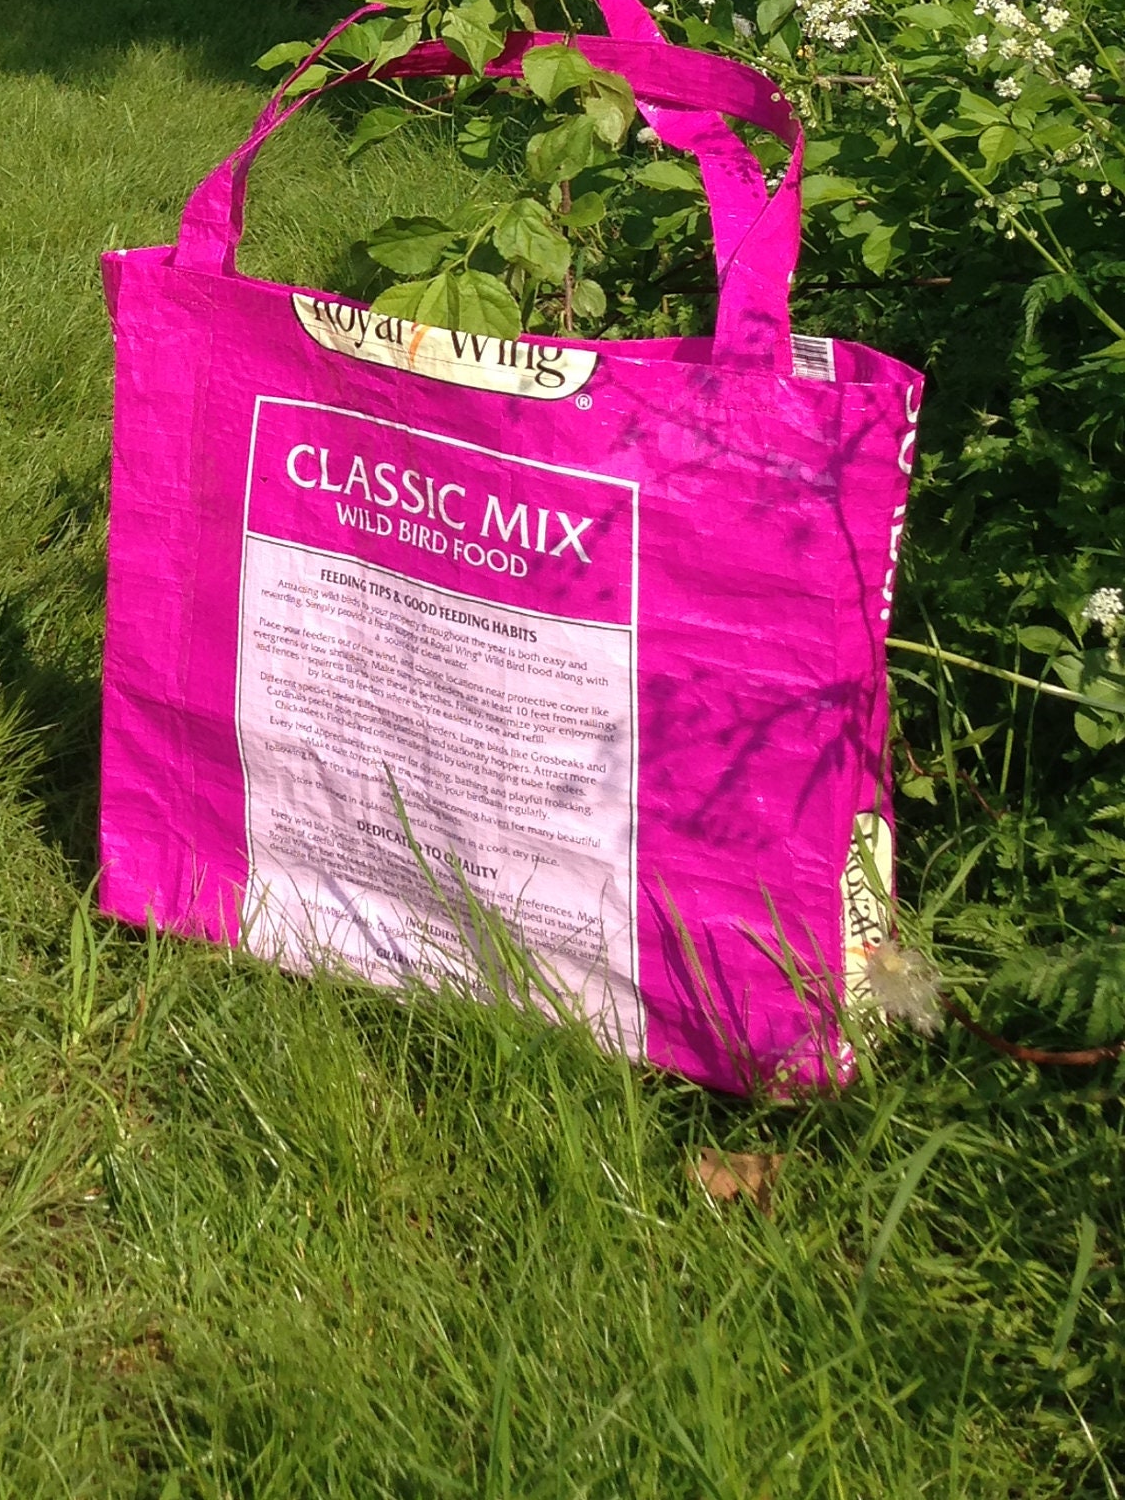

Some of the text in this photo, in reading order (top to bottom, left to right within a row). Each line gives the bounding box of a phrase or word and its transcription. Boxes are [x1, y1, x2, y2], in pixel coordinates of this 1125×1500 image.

[286, 444, 593, 564] CLASSIC MIX
[335, 501, 528, 578] WILD BIRD FOOD
[321, 569, 537, 643] FEEDING TIPS & GOOD FEEDING HABITS
[518, 648, 540, 662] both
[543, 656, 566, 669] easy
[568, 659, 587, 670] and
[507, 661, 524, 672] Bird
[527, 663, 552, 677] Food
[555, 670, 583, 685] along
[586, 676, 608, 686] with
[507, 693, 557, 710] protective
[560, 702, 588, 715] cover
[592, 706, 608, 717] like
[516, 706, 527, 716] 10
[531, 709, 550, 721] feet
[553, 713, 577, 725] from
[533, 719, 615, 743] your enjoyment
[460, 732, 606, 773] Large like Grosbeaks and
[521, 778, 544, 790] tube
[534, 766, 596, 785] Attract more
[509, 793, 543, 807] playful
[528, 827, 600, 848] many beautiful
[425, 844, 441, 860] TO
